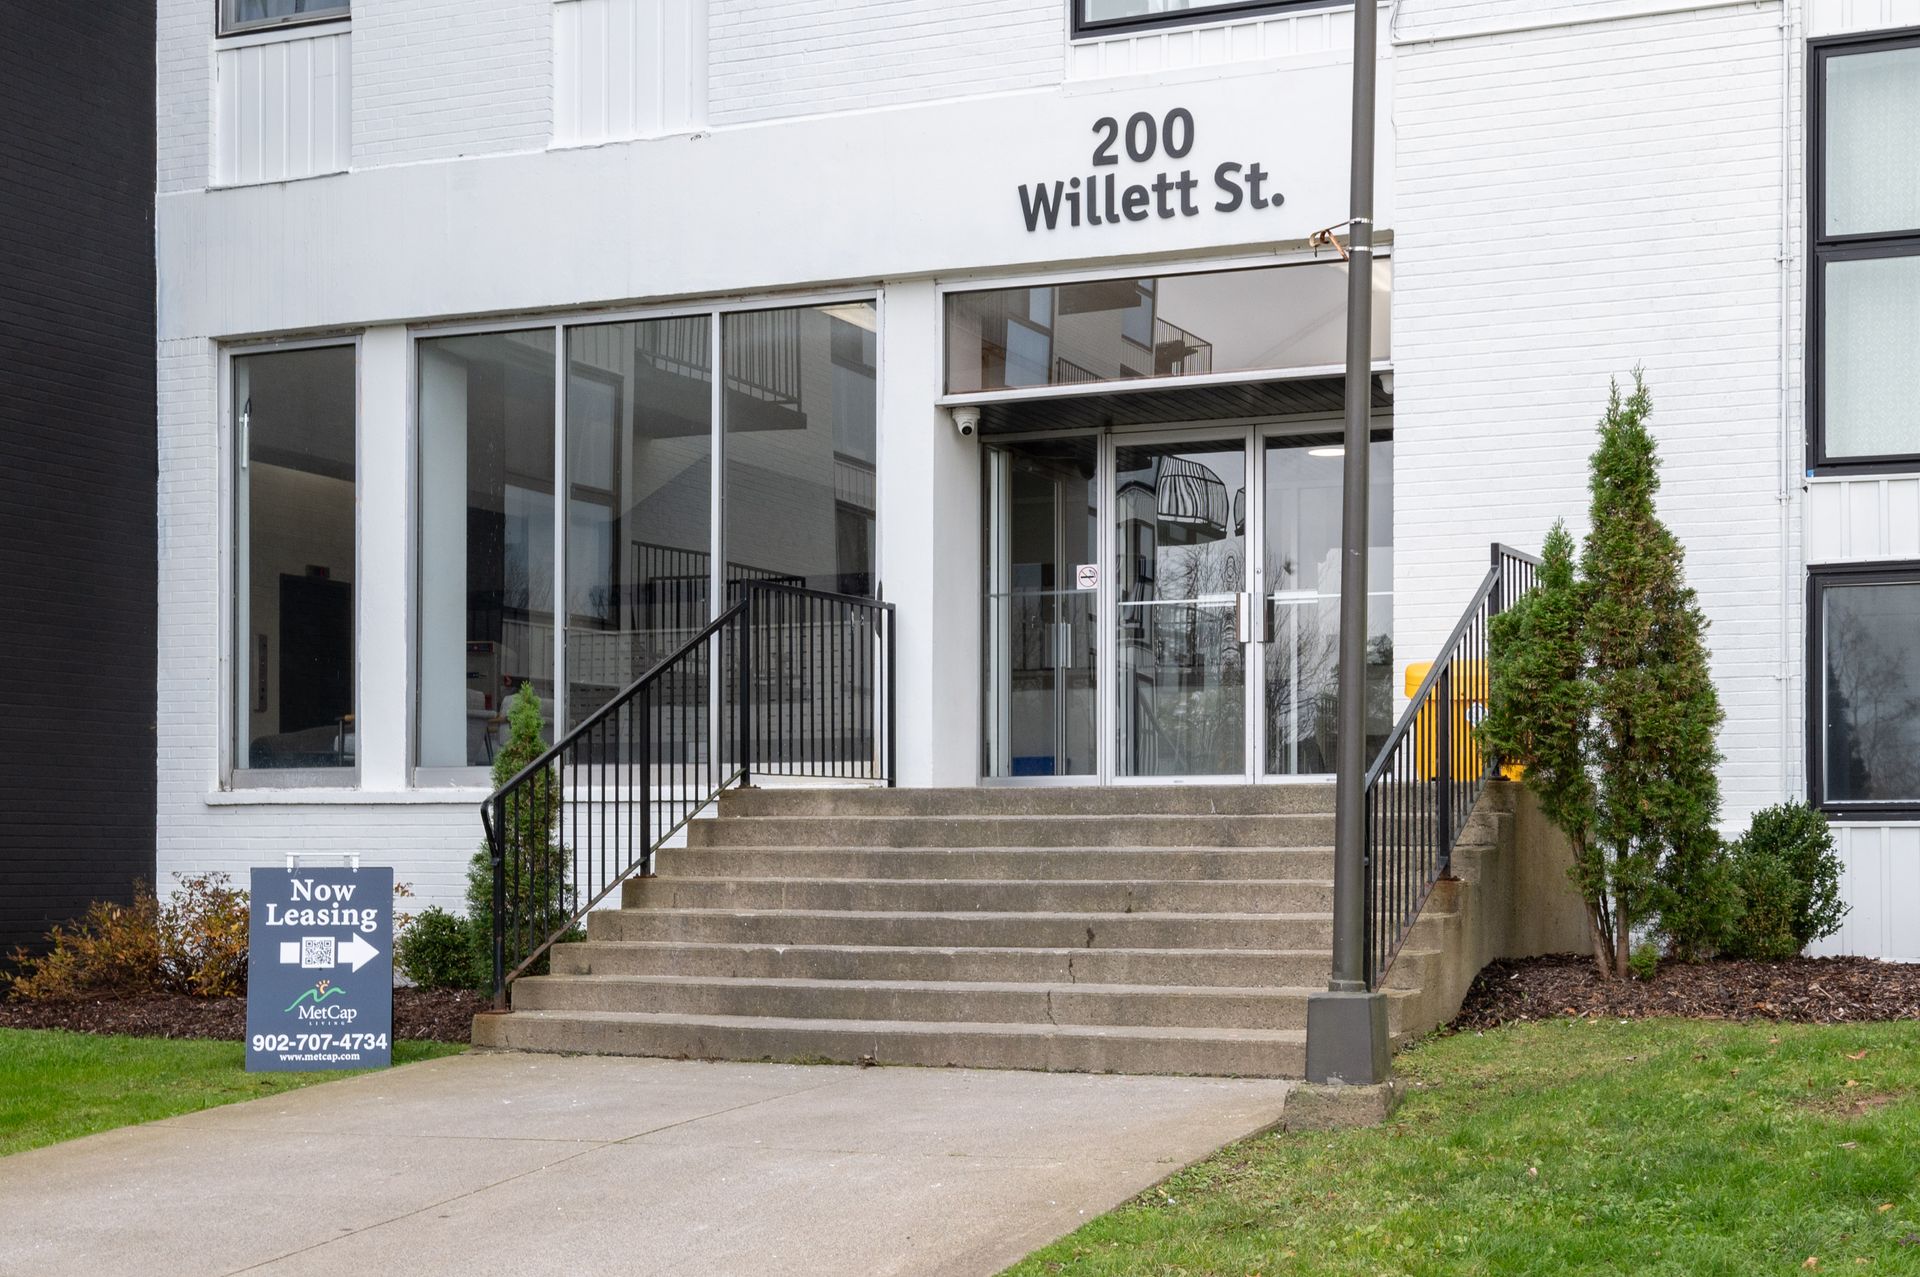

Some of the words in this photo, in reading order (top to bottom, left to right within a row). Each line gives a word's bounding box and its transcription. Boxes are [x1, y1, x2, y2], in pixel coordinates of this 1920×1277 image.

[1091, 107, 1195, 167] 200
[1017, 169, 1200, 232] Willett
[1214, 161, 1285, 213] St.
[290, 879, 356, 902] Now
[265, 902, 378, 933] Leasing
[298, 1004, 358, 1023] MetCap
[252, 1033, 388, 1052] 902-707-4734
[279, 1052, 360, 1063] www.metcap.com
